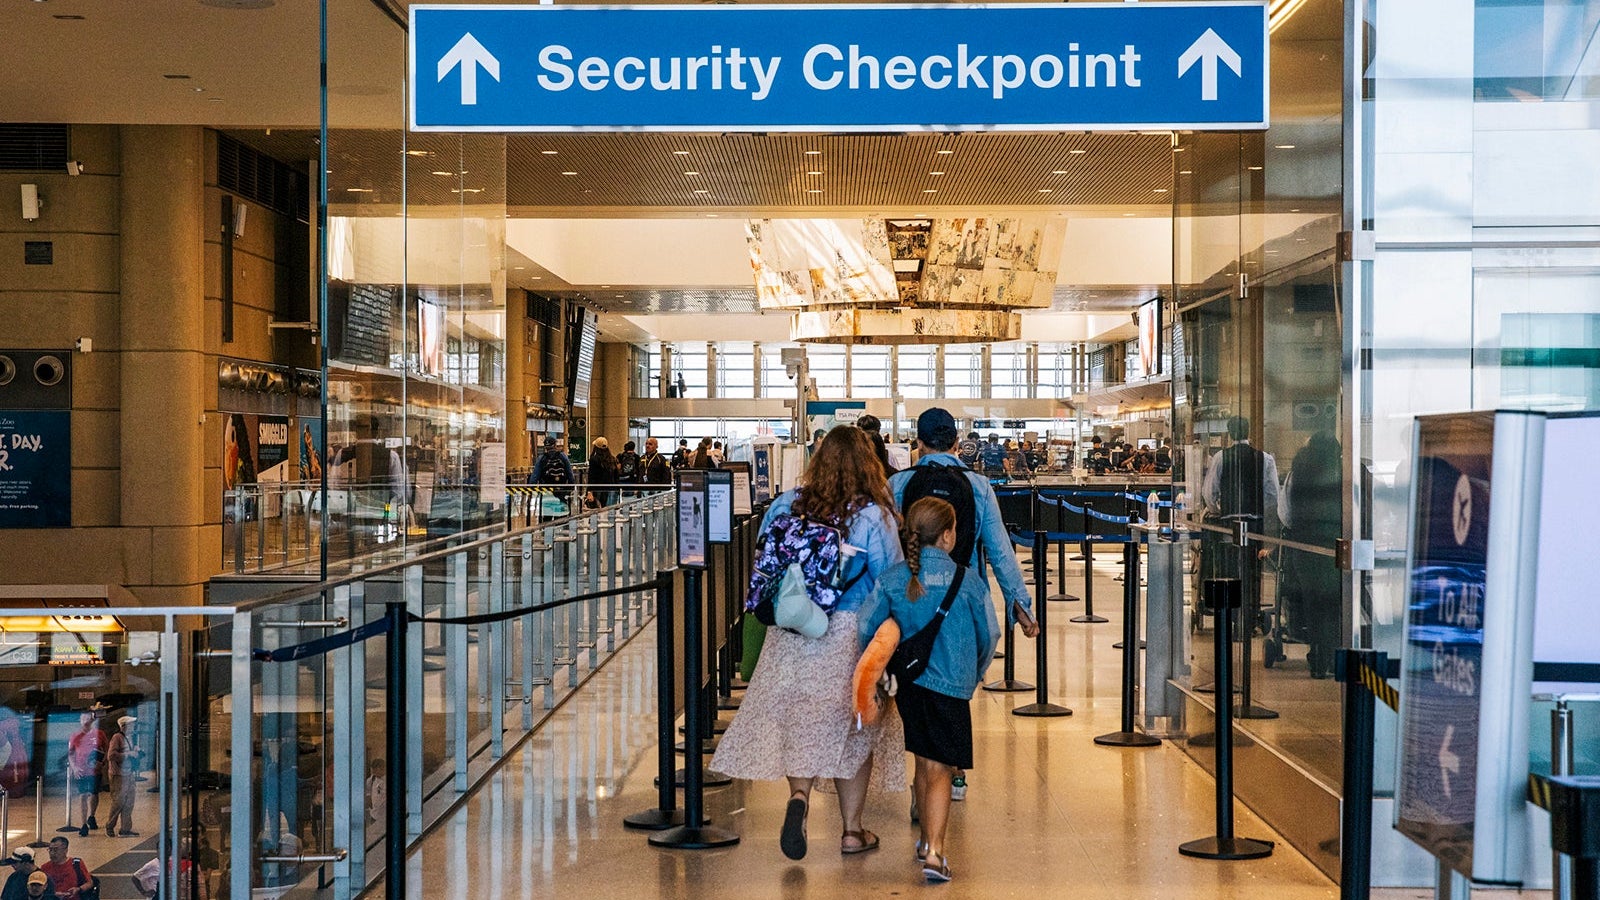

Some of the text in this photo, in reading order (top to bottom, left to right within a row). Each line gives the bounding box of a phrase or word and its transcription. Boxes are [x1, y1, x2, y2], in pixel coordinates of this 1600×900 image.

[538, 43, 1140, 100] Security Checkpoint
[12, 433, 43, 452] DAY.
[259, 423, 287, 445] SMUGGLED
[1437, 577, 1455, 623] To
[13, 652, 33, 661] C32
[1433, 638, 1475, 696] Gates
